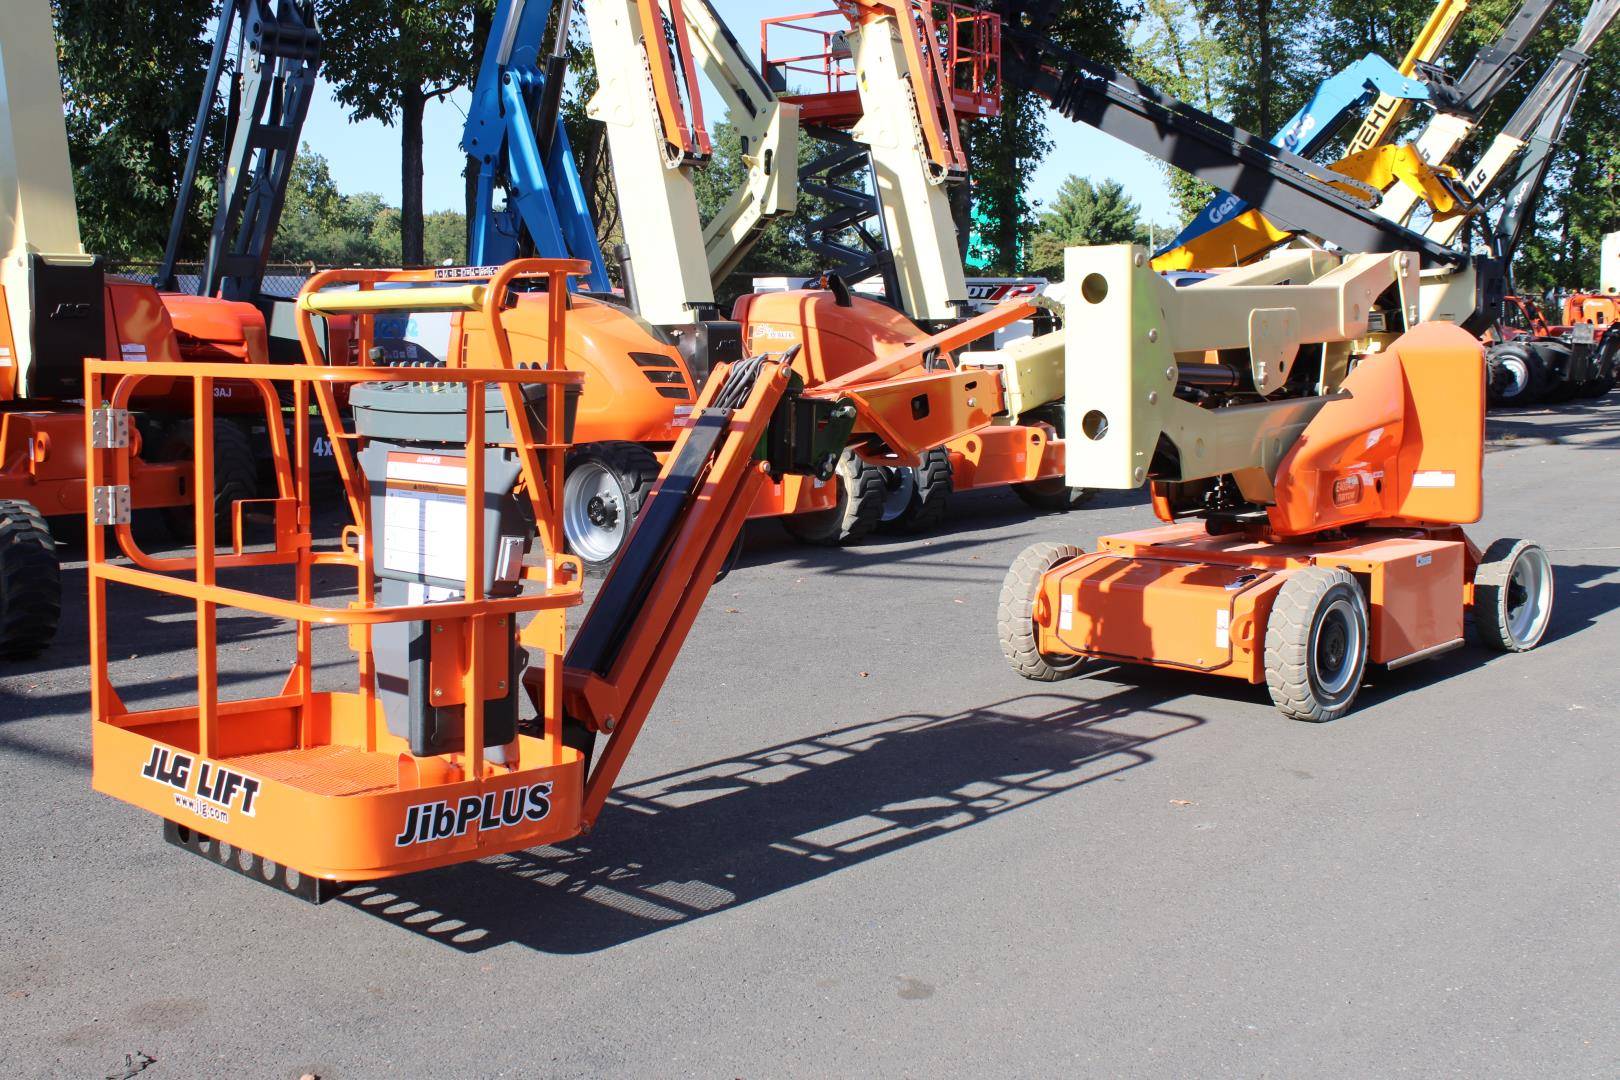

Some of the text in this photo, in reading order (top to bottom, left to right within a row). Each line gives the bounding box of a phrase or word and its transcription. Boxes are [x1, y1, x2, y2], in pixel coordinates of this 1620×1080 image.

[141, 744, 260, 815] JLG LIFT
[174, 793, 229, 822] www.jlg.com
[396, 782, 552, 846] JibPLUS
